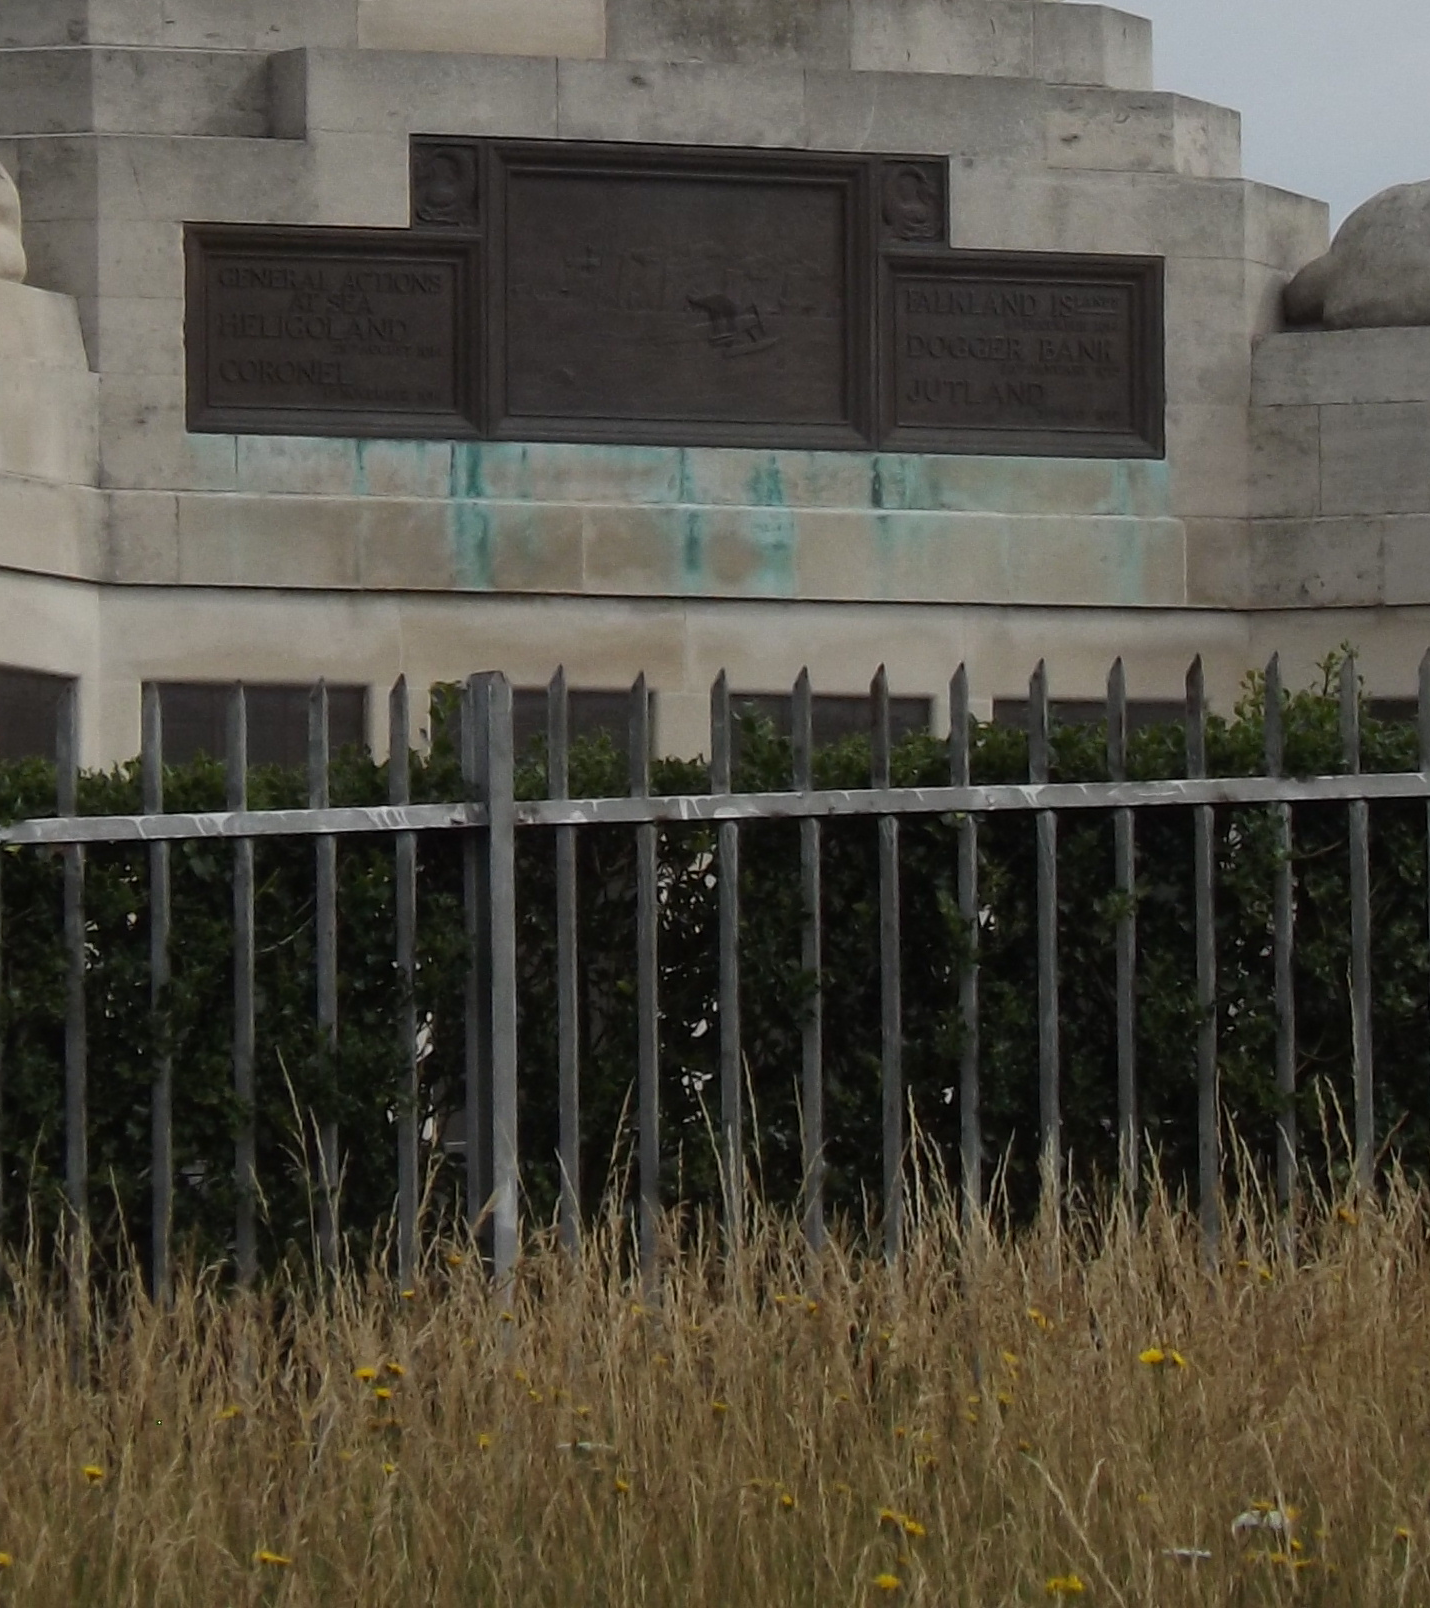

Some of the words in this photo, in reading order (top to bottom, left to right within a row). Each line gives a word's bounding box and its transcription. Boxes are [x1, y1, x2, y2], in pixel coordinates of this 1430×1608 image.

[217, 267, 330, 290] GENERAL
[338, 271, 442, 294] ACTIONS
[287, 293, 322, 314] AT
[325, 293, 375, 315] SEA
[905, 289, 1037, 316] FALKLAND
[216, 313, 408, 342] HELIGOLAND
[906, 334, 1021, 361] DOGGER
[1037, 338, 1113, 363] BANK
[218, 359, 356, 385] CORONEL
[906, 378, 1045, 406] JUTLAND
